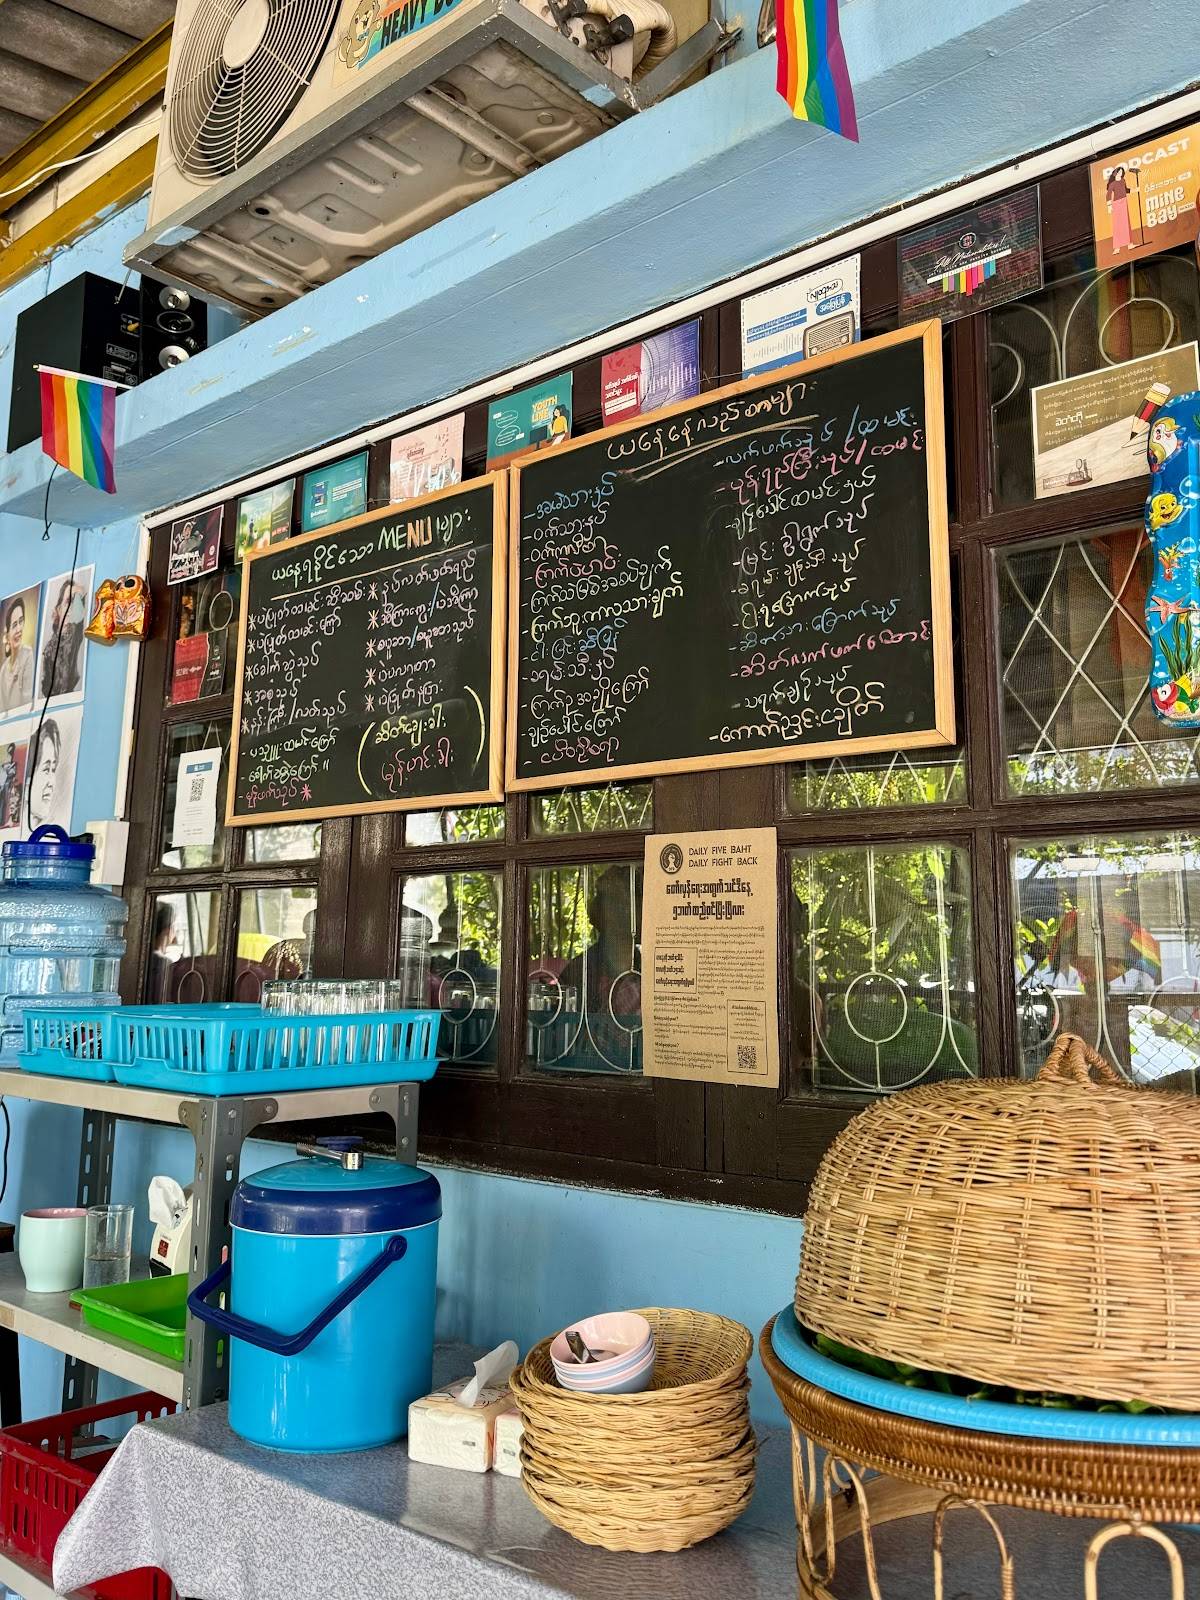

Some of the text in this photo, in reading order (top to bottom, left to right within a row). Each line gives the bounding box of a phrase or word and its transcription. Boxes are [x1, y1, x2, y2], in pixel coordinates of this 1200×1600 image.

[380, 0, 428, 50] HEAVY
[378, 516, 432, 551] MENU
[688, 844, 752, 856] DAILY FIVE BAHT
[688, 856, 758, 868] DAILY FIGHT BACK
